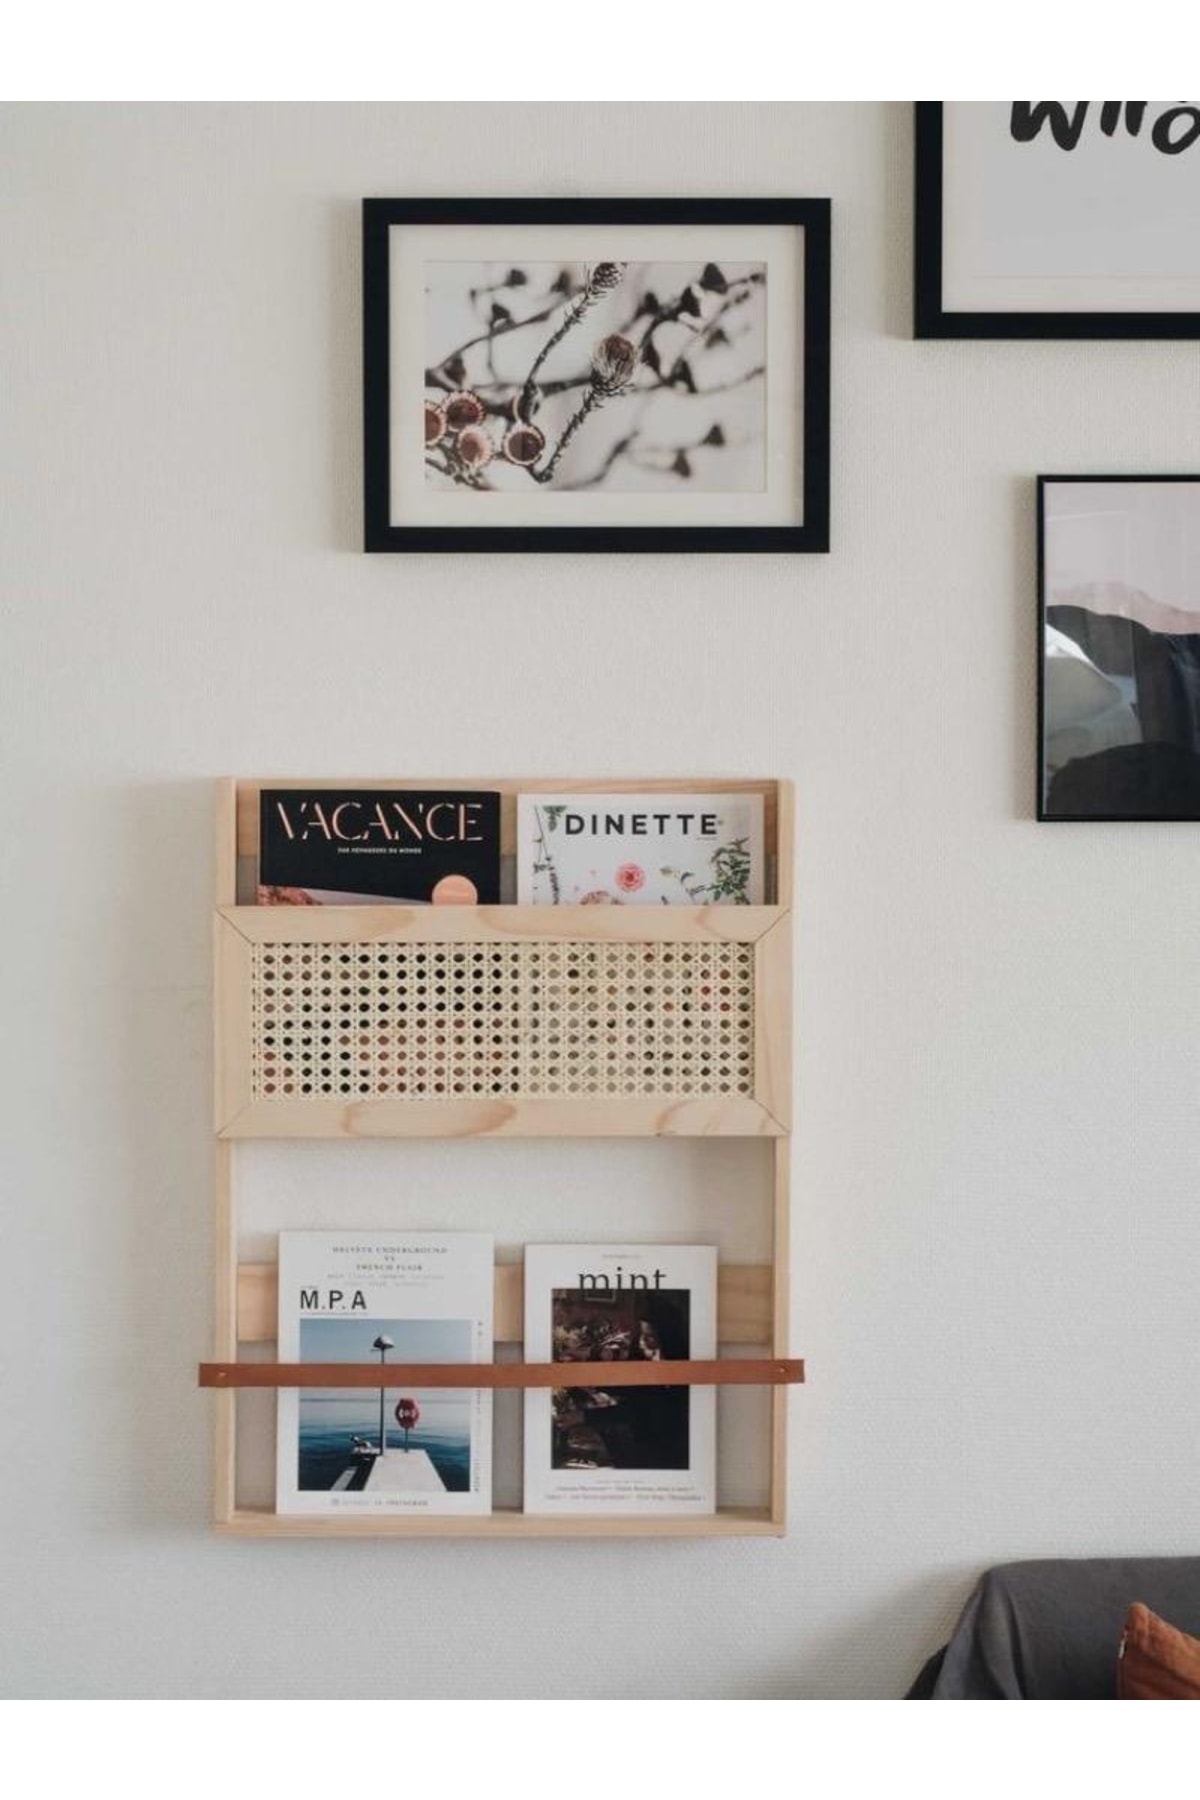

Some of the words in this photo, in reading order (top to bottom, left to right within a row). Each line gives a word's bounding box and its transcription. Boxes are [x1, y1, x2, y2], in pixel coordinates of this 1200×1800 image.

[277, 802, 483, 840] VACANCE
[565, 815, 717, 835] DINETTE
[578, 1266, 667, 1290] mint
